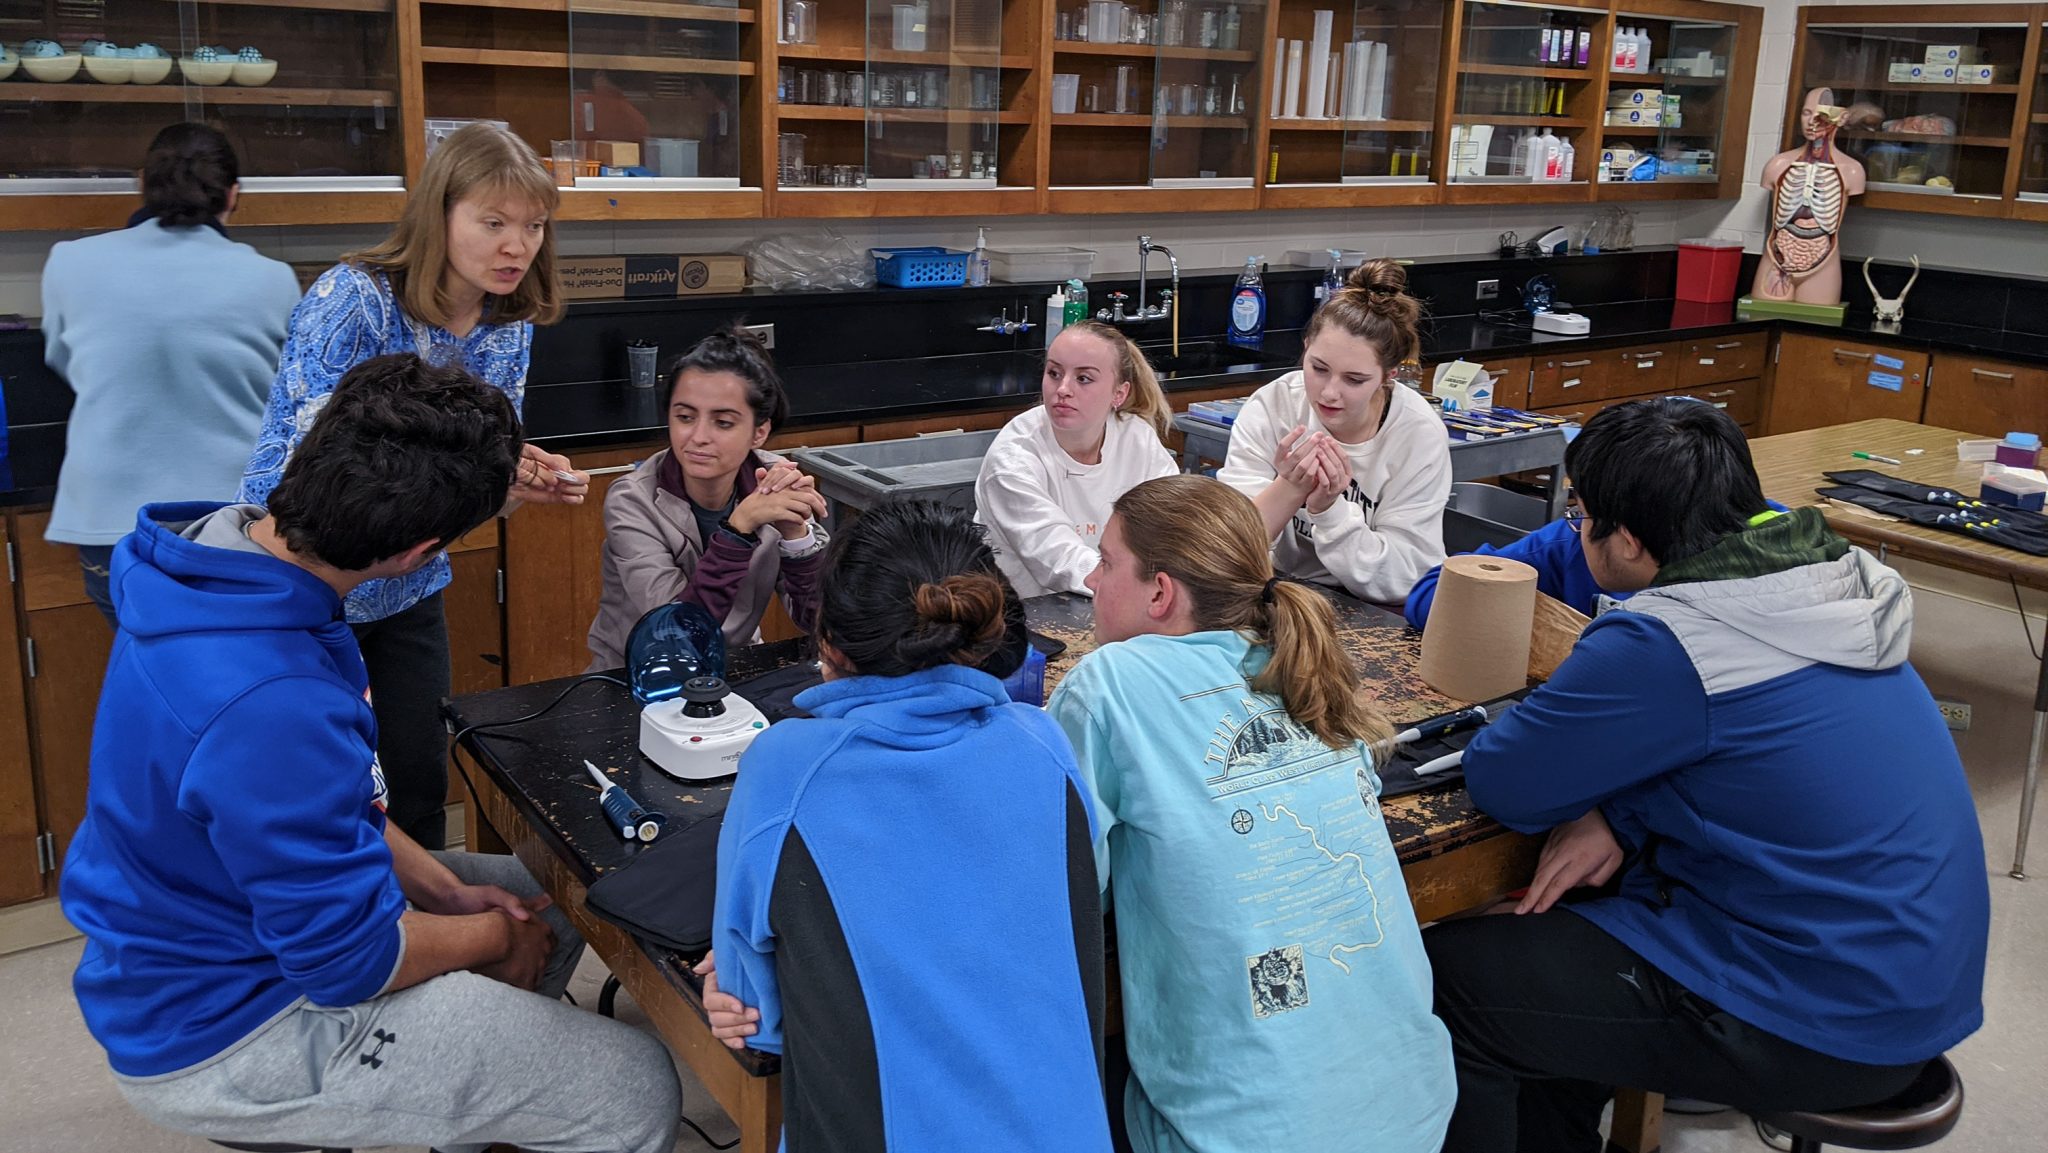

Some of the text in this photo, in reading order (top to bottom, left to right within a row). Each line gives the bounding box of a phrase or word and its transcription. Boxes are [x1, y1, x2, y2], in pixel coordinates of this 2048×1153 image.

[628, 268, 677, 284] ArtKraft
[1203, 711, 1241, 766] THE
[1217, 777, 1250, 795] WORLD
